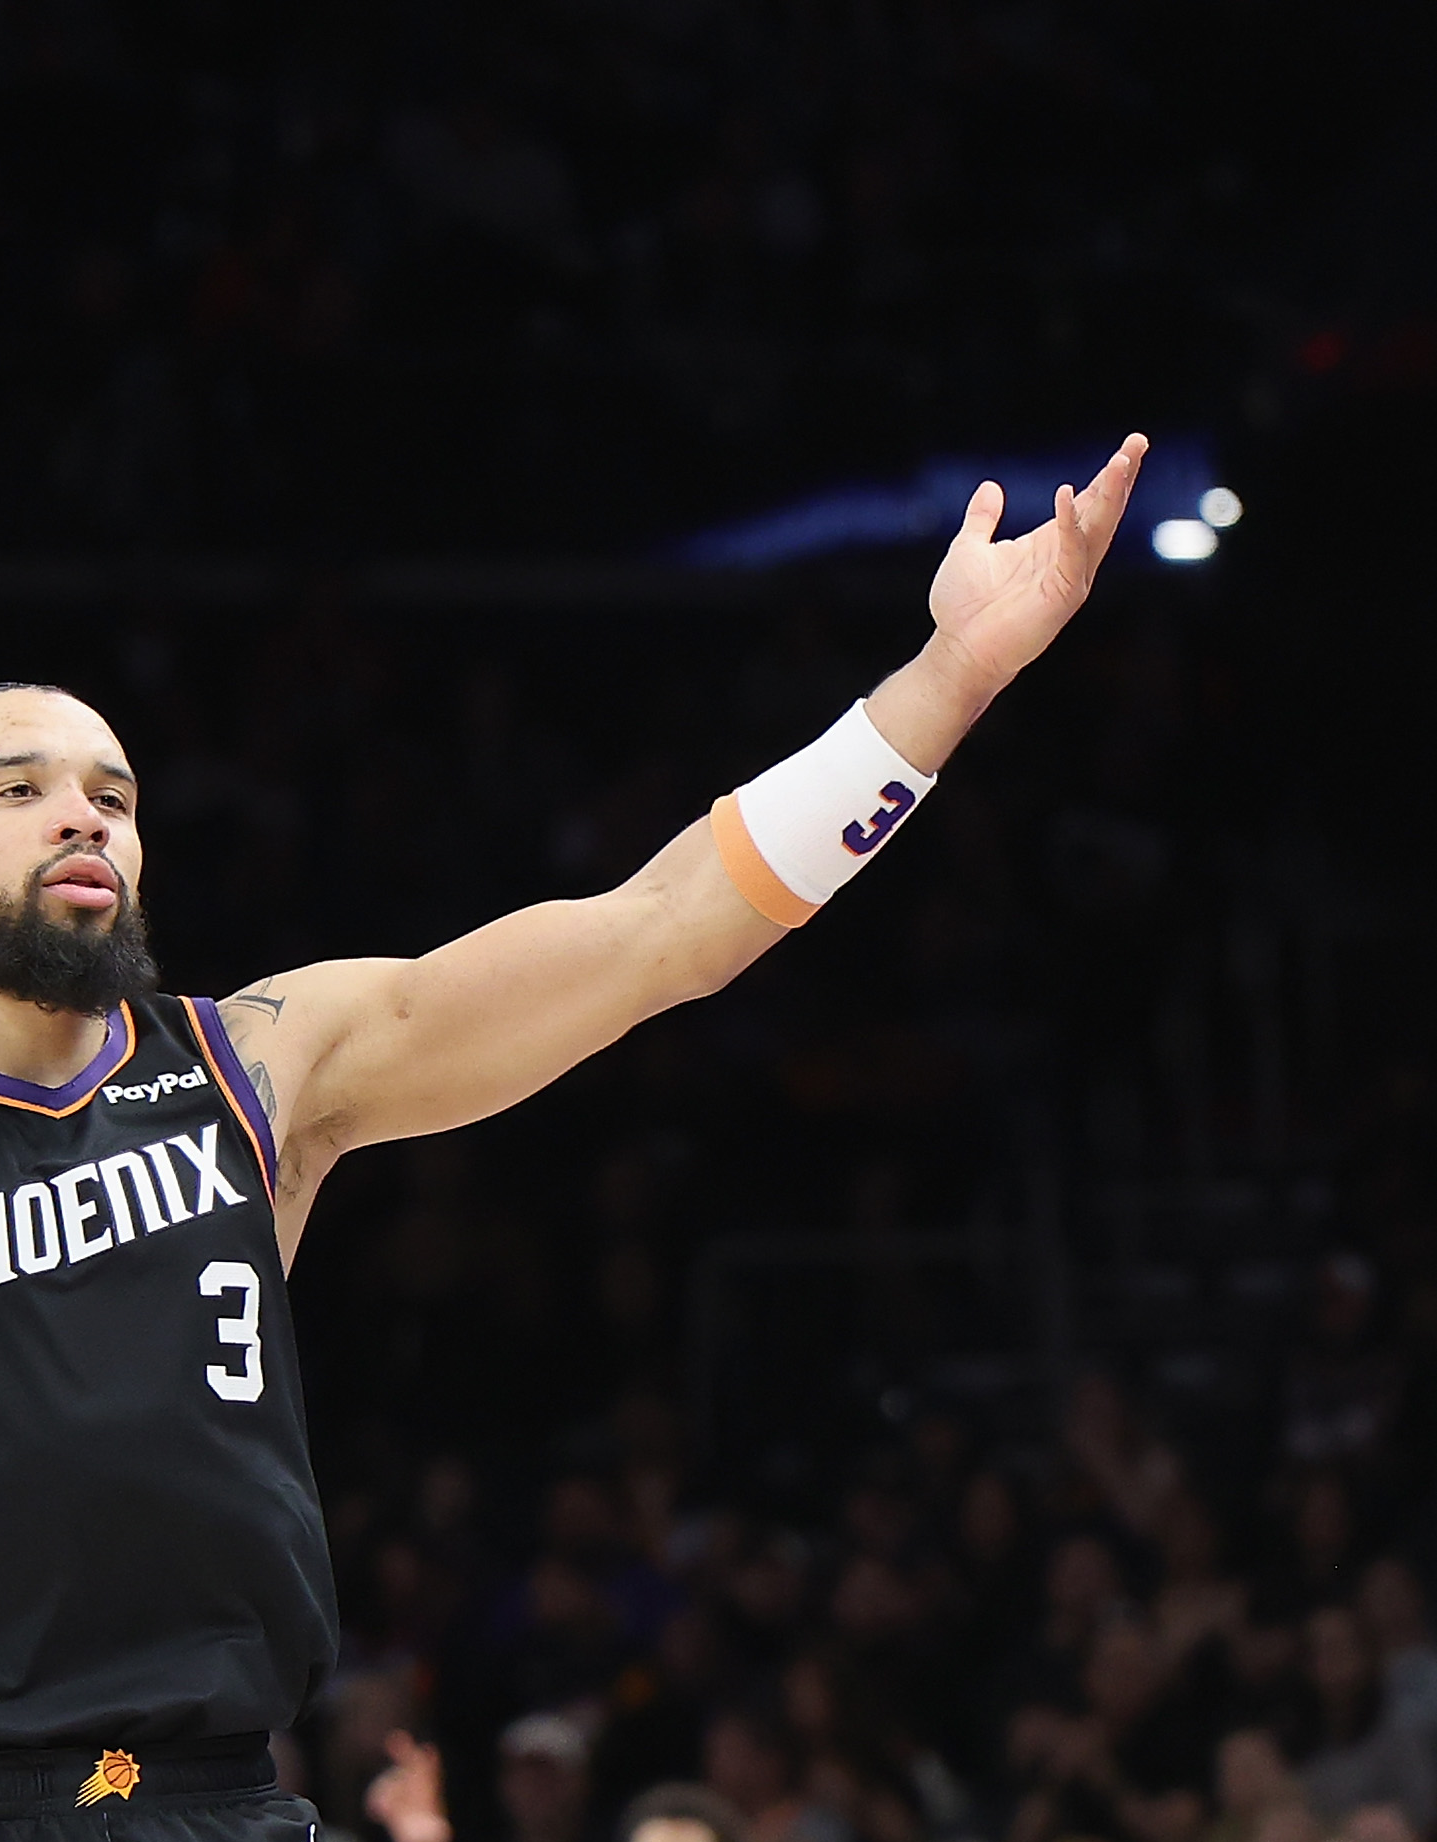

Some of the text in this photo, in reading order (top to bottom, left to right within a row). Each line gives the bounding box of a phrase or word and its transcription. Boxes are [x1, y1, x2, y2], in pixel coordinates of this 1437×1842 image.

[841, 780, 917, 857] 3
[102, 1065, 209, 1104] PayPal
[198, 1261, 265, 1402] 3
